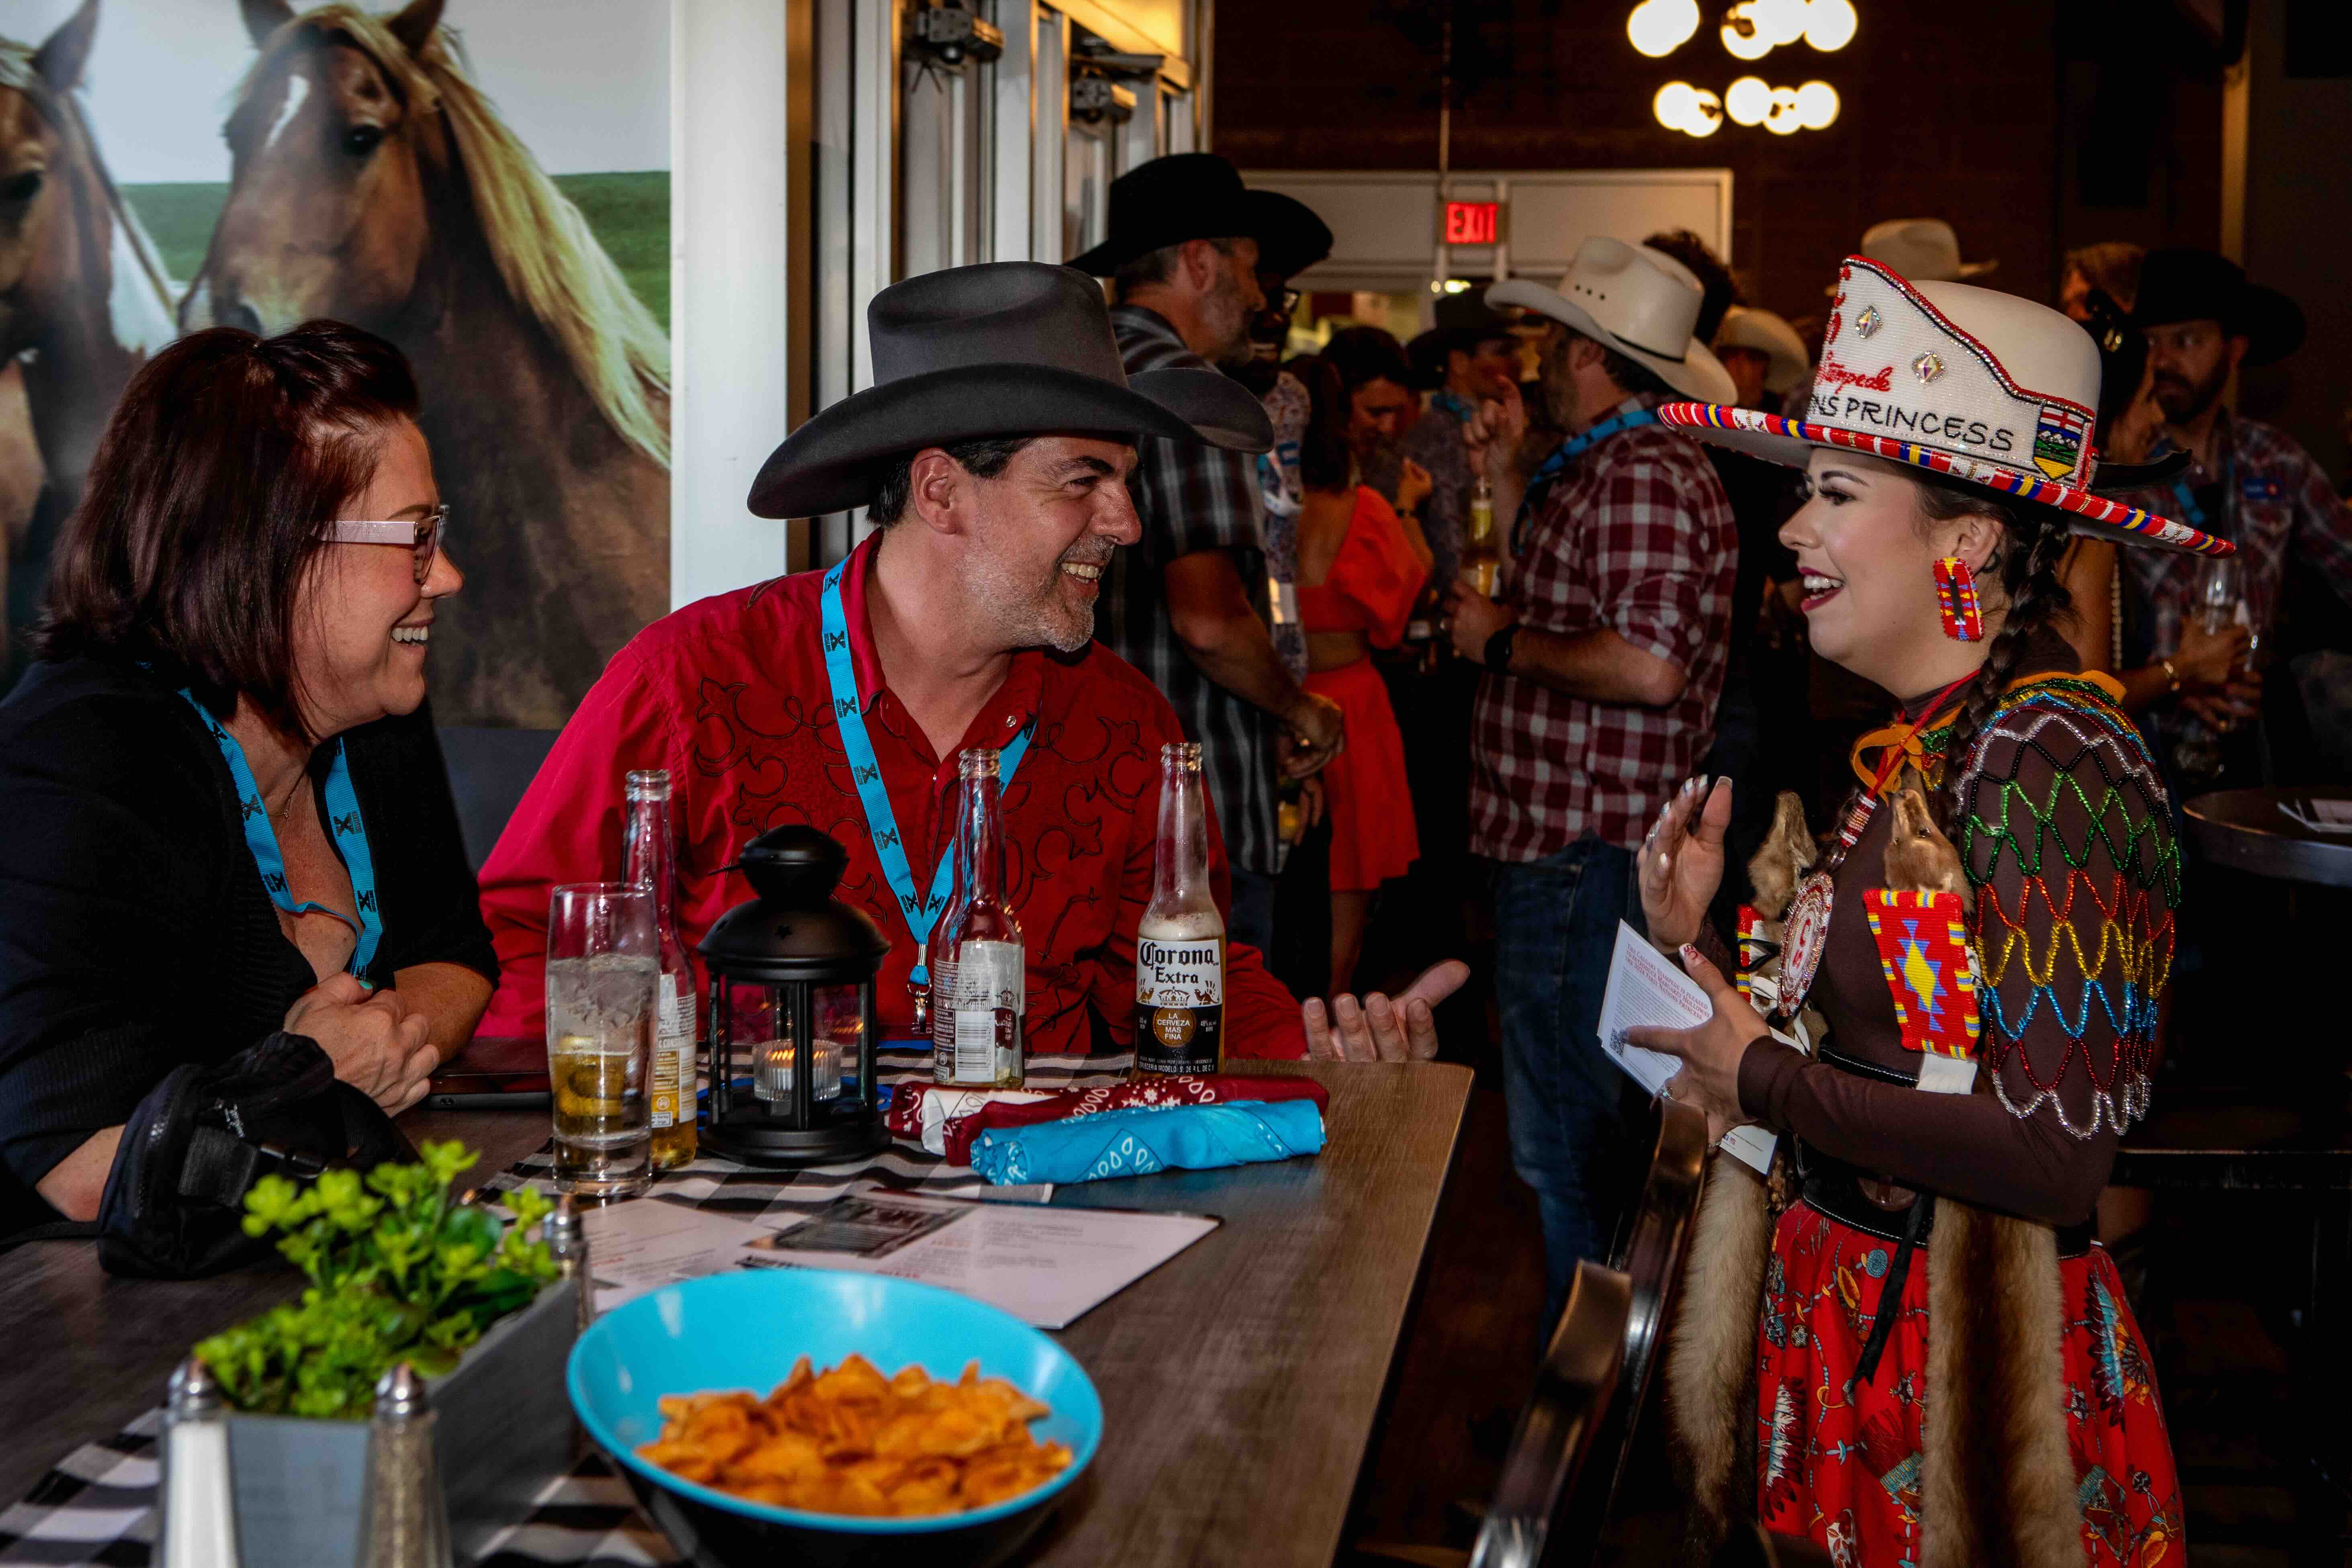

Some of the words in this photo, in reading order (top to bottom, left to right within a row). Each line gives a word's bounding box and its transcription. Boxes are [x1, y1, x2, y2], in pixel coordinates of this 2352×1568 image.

[1846, 397, 2014, 451] PRINCESS
[1140, 941, 1219, 970] Corona
[1155, 966, 1199, 985] Extra
